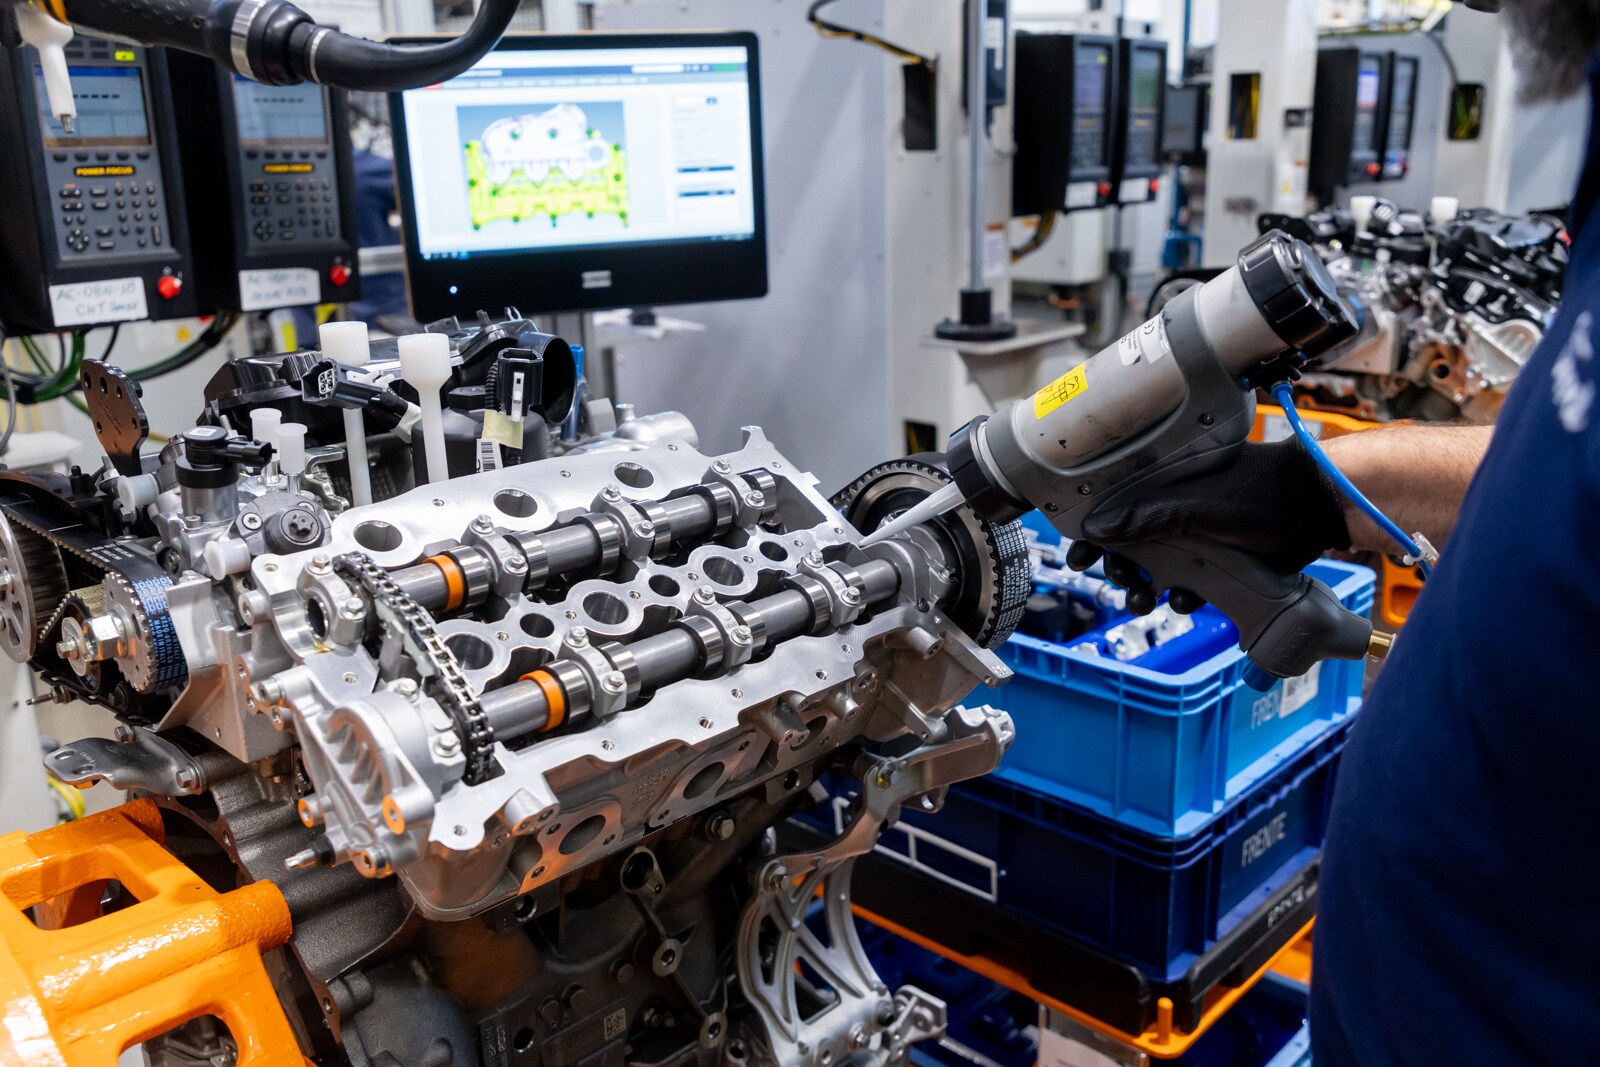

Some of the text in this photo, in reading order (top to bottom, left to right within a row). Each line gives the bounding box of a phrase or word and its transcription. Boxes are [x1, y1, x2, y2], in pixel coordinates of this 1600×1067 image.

[76, 166, 133, 176] POWER FOCUS
[153, 619, 164, 638] MADE
[159, 647, 168, 665] ITALY
[1241, 811, 1288, 867] FRENTE
